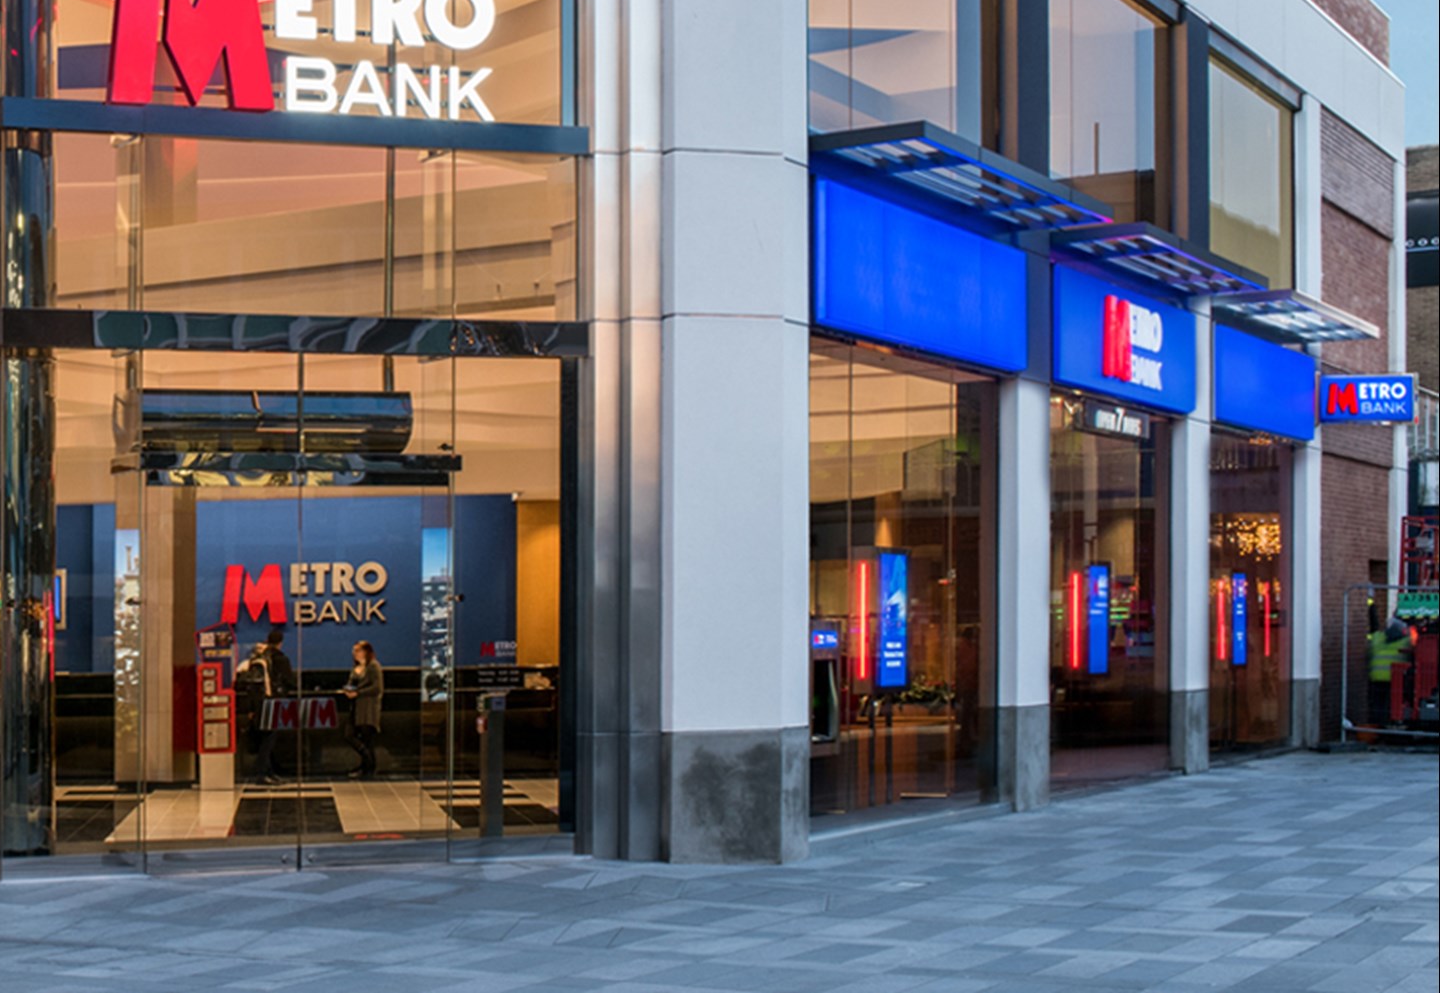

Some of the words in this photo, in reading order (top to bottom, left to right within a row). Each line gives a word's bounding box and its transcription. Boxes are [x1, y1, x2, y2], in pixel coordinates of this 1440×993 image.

[286, 55, 495, 123] BANK
[1103, 294, 1162, 382] METRO
[1131, 354, 1162, 392] BANK
[1327, 382, 1407, 415] METRO
[1361, 401, 1407, 414] BANK
[1115, 407, 1126, 432] 7
[220, 560, 388, 626] METRO
[293, 598, 387, 625] BANK
